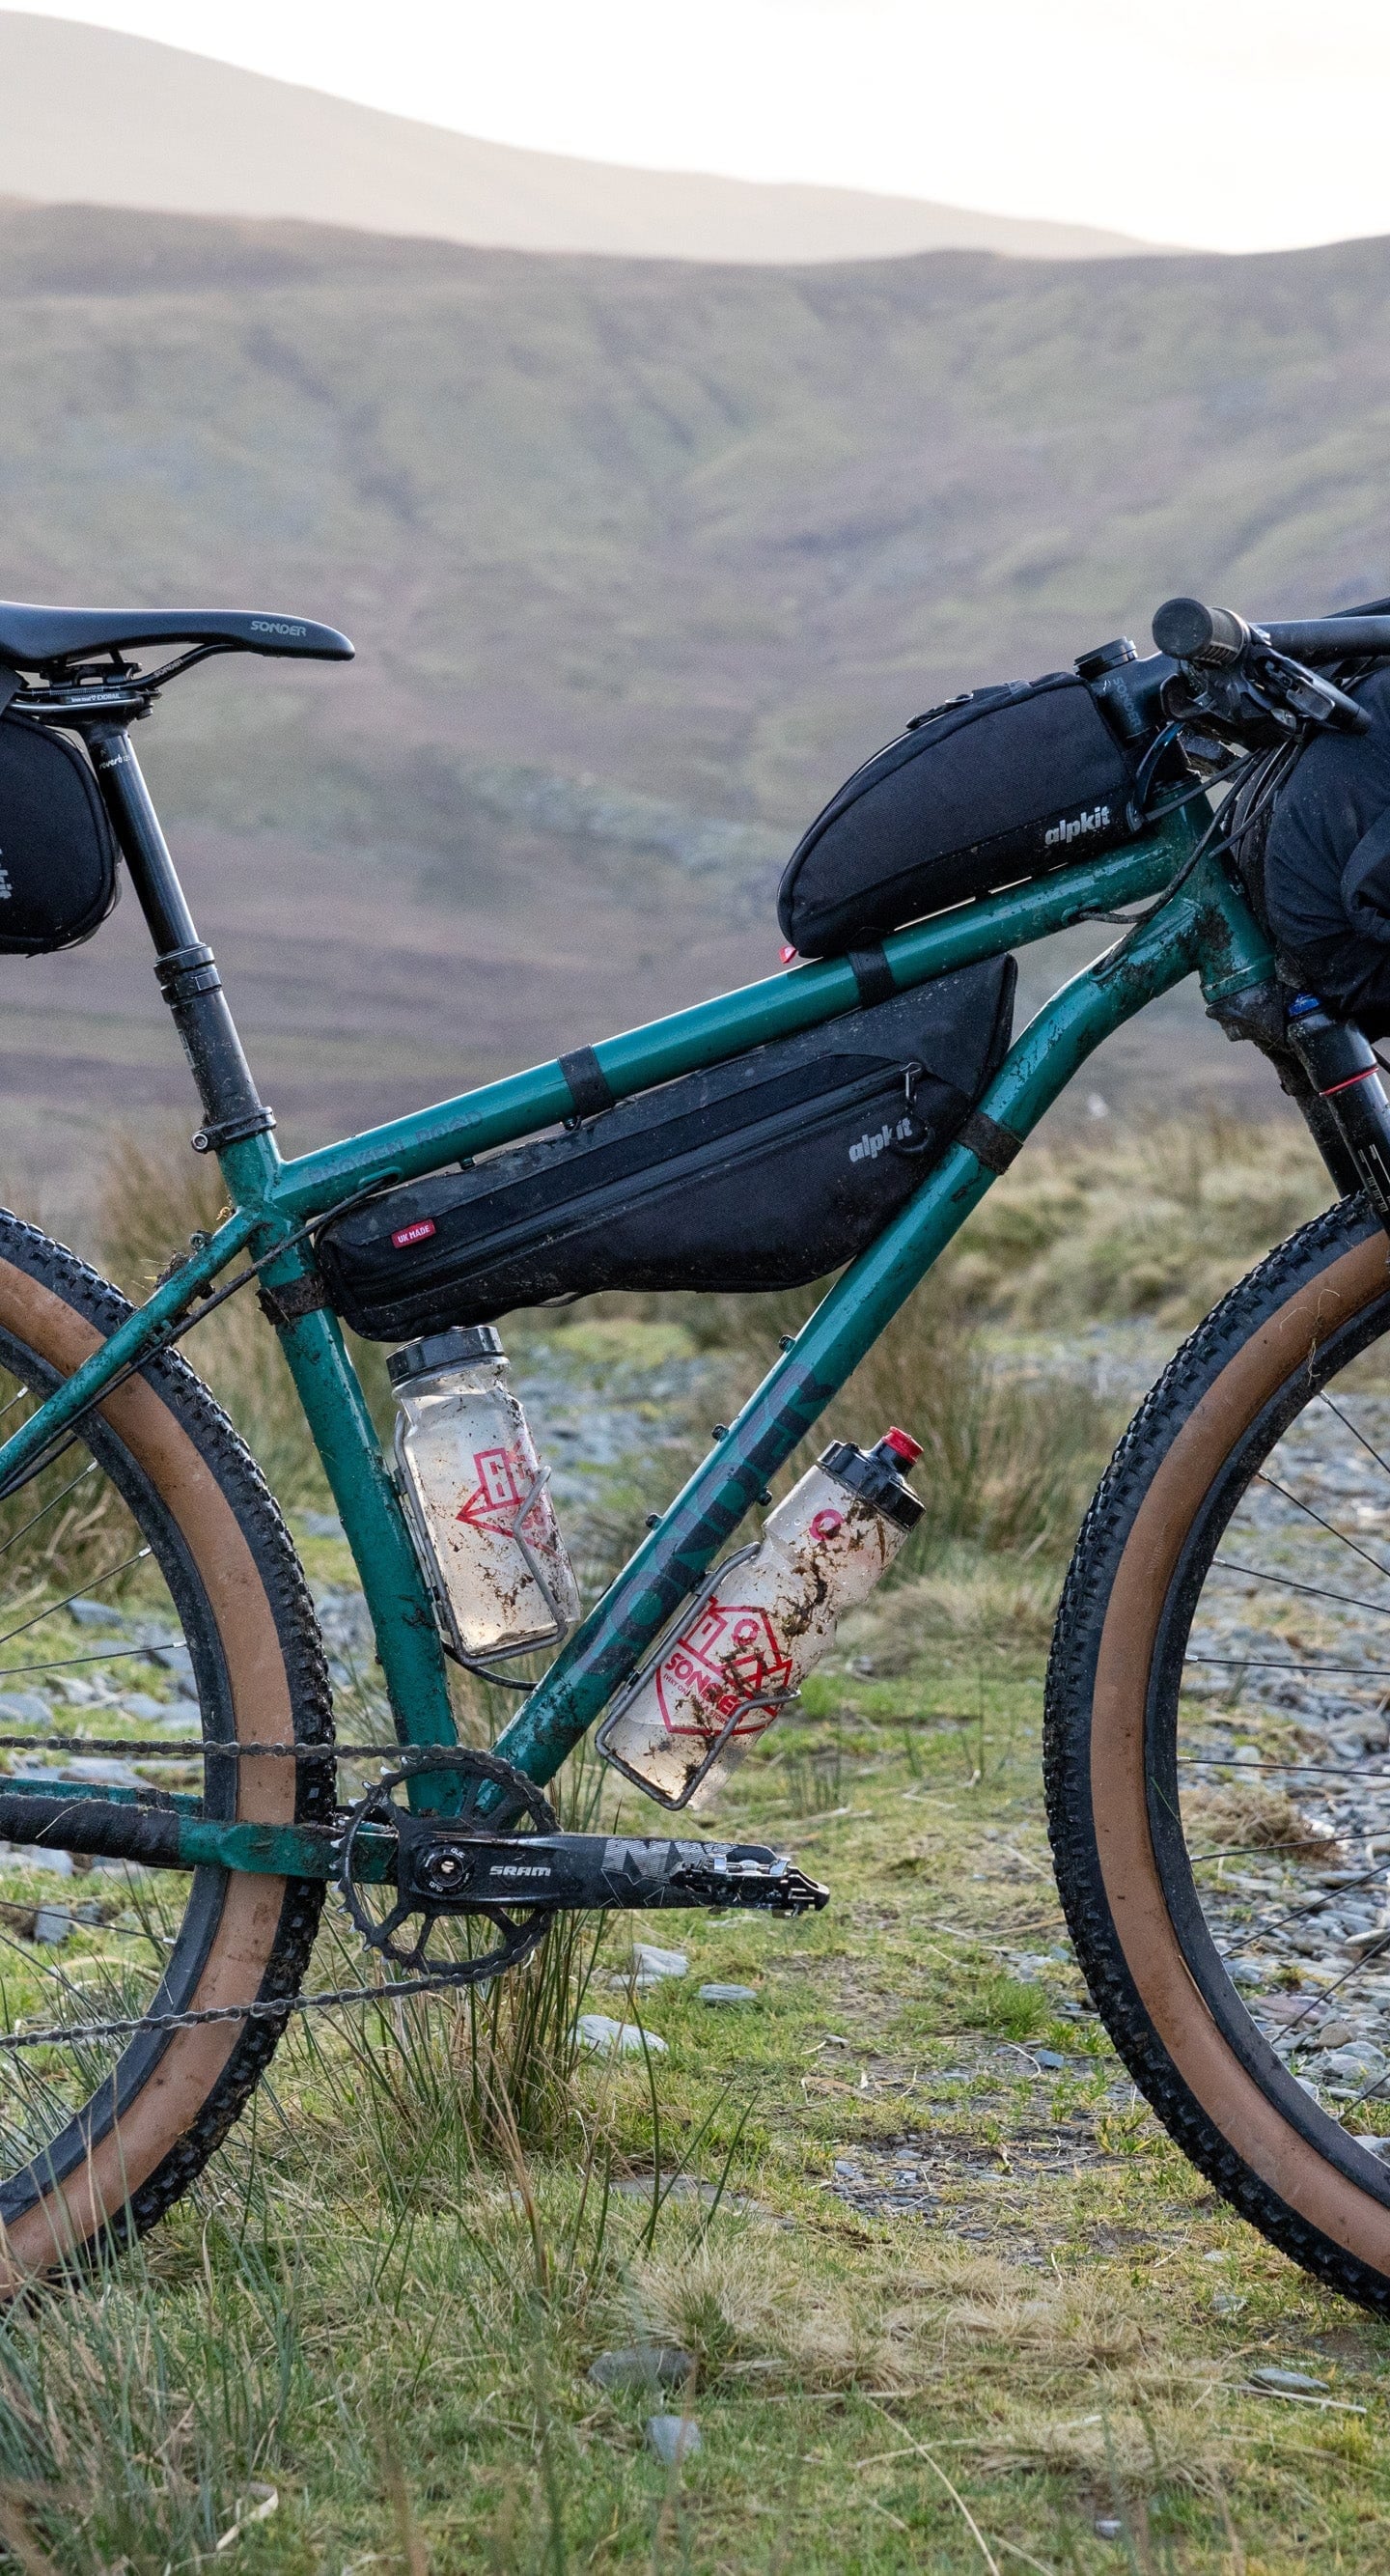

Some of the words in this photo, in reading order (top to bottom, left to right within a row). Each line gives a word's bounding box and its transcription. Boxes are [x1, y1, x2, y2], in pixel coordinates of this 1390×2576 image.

[251, 621, 307, 636] SONDER
[1113, 677, 1143, 733] SONDER
[1044, 805, 1110, 845] alpkit
[397, 1233, 409, 1244] UK
[408, 1224, 431, 1240] MADE
[574, 1363, 836, 1675] SONDER
[488, 1865, 551, 1877] SRAM
